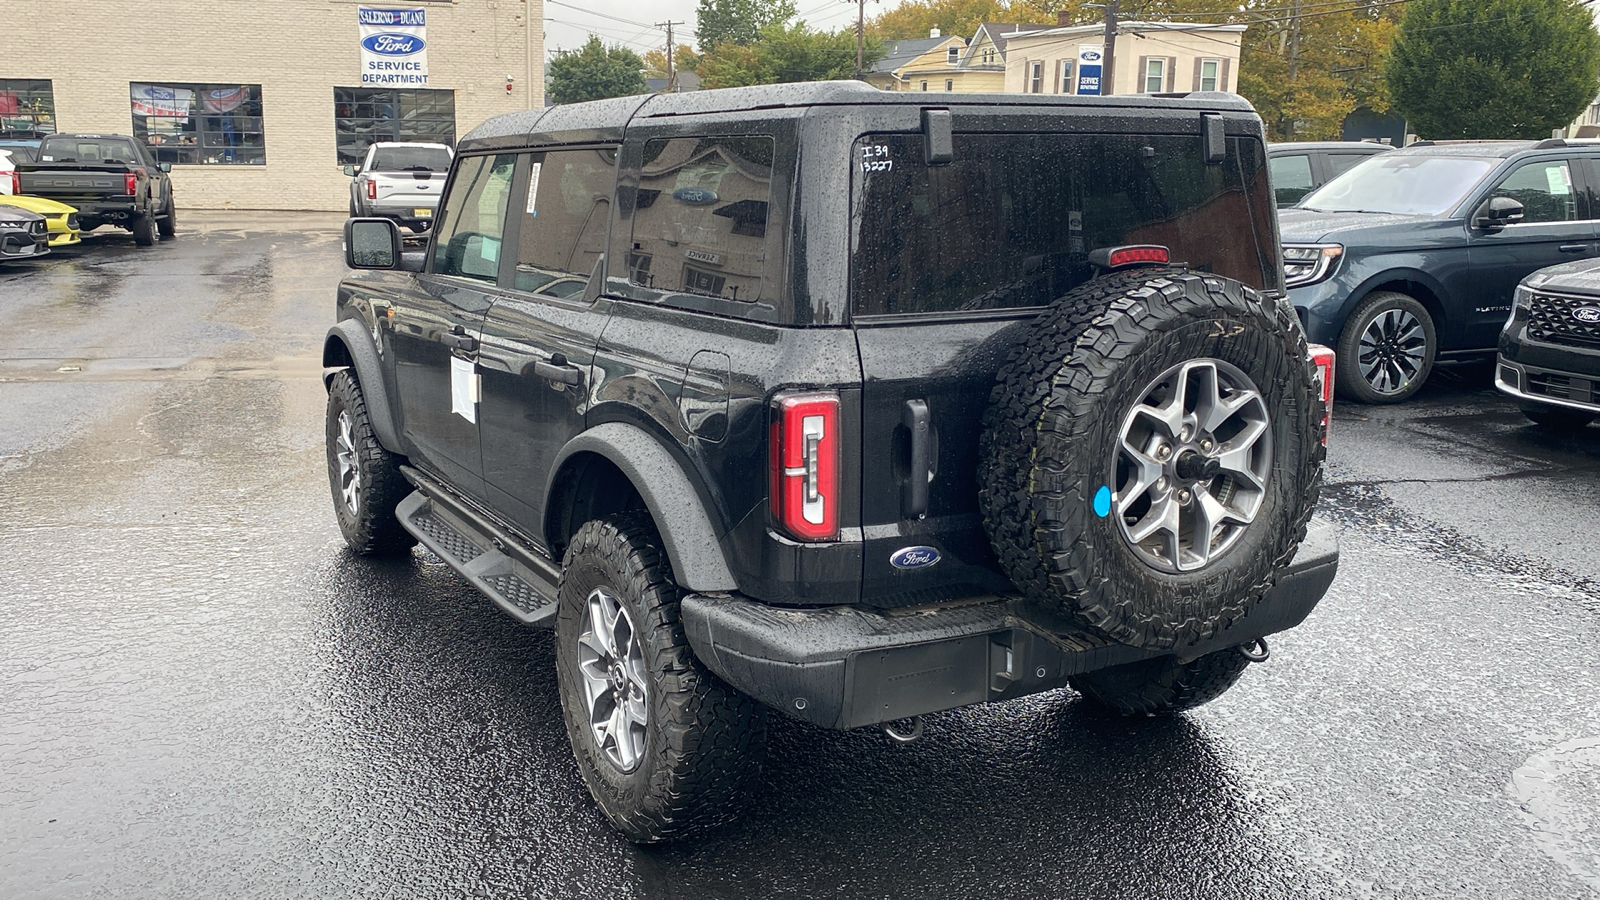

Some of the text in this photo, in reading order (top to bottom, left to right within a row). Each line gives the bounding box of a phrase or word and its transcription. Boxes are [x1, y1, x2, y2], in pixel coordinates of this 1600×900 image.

[360, 10, 425, 25] SALERNO DUANE
[374, 35, 413, 52] Ford
[1083, 51, 1099, 60] Ford
[368, 60, 421, 71] SERVICE
[362, 73, 428, 83] DEPARTMENT
[860, 160, 893, 172] 13227
[1577, 310, 1599, 321] Ford
[902, 550, 931, 566] Ford
